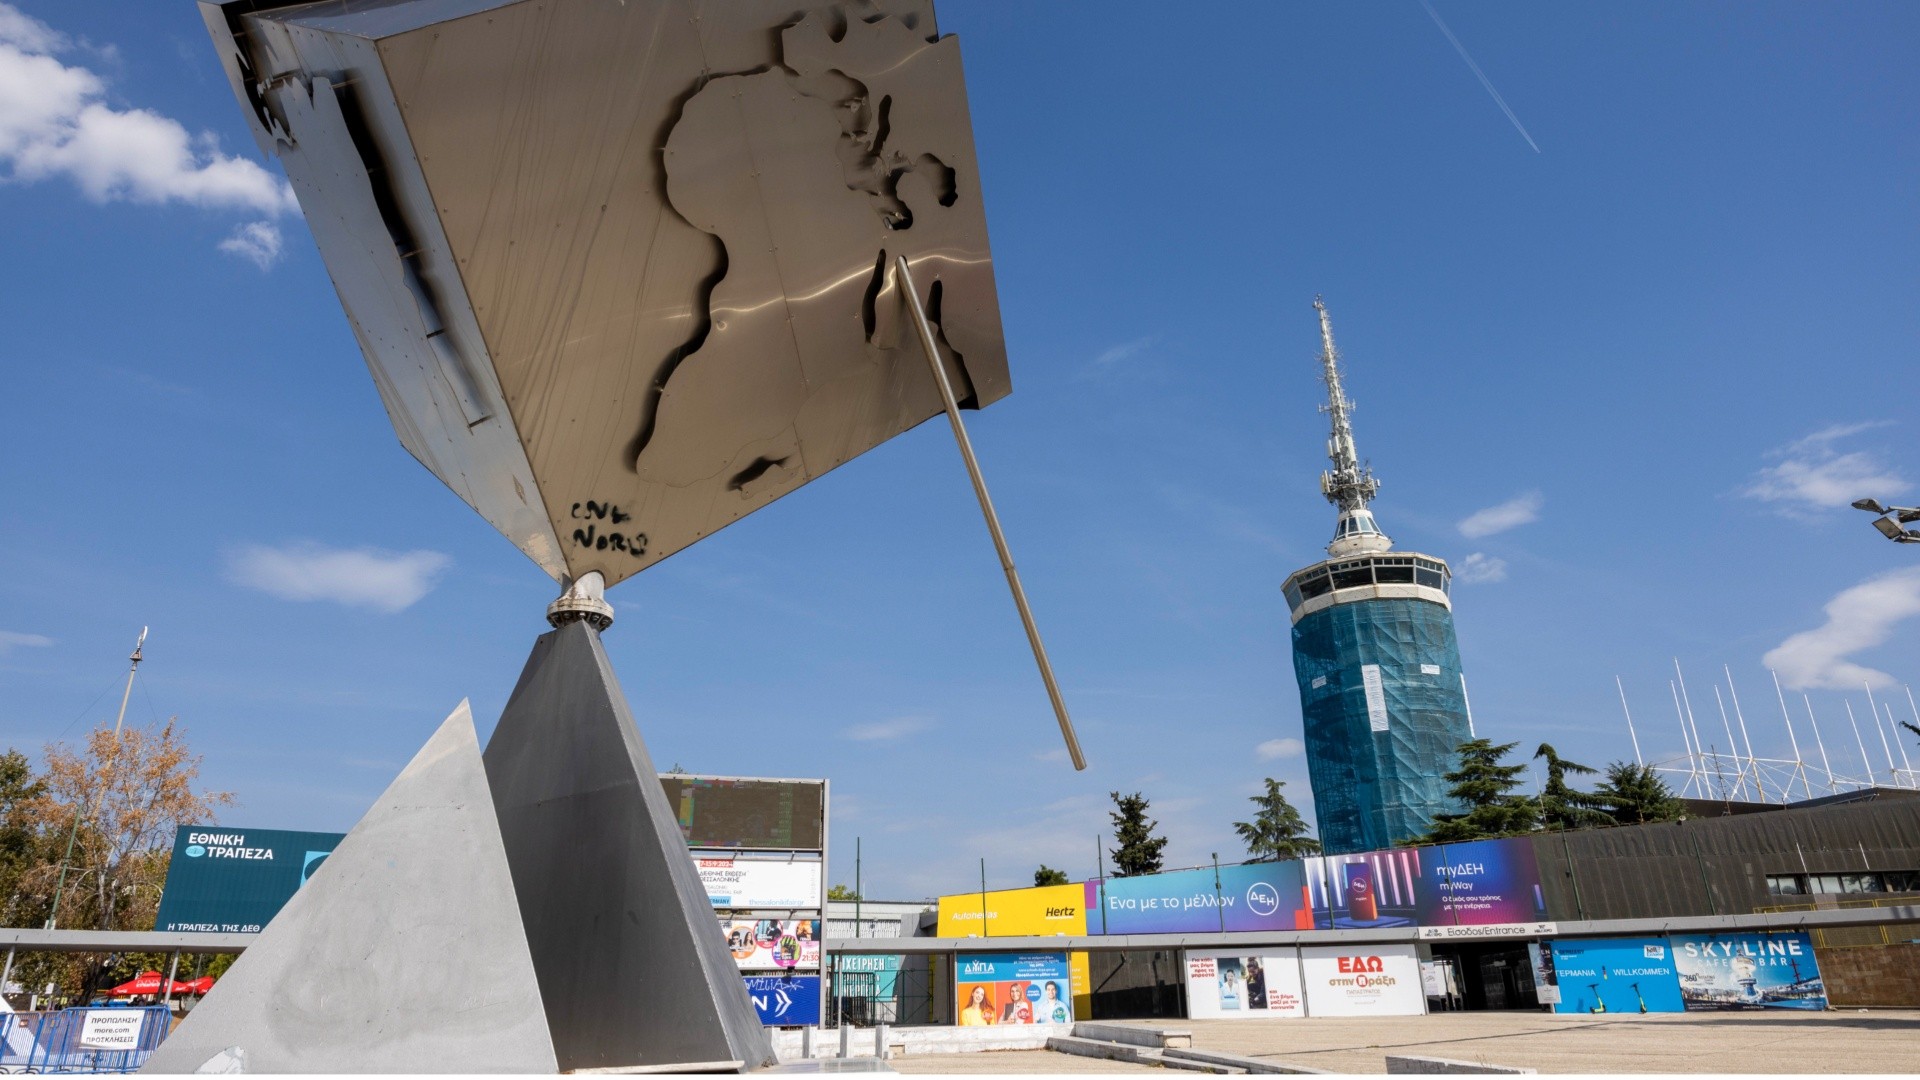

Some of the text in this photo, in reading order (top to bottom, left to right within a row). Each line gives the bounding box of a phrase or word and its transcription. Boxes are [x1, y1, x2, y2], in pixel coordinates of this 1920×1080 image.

[188, 832, 245, 846] ΕΘΝΙΚΗ
[207, 846, 274, 860] ΤΡΑΠΕΖΑ
[1440, 882, 1473, 891] myWay
[1108, 894, 1235, 912] Ένα με το μέλλον
[1250, 892, 1275, 906] ΔΕΗ
[952, 911, 998, 921] Autoheas
[1046, 907, 1075, 917] Hertz
[178, 924, 219, 932] ΤΡΑΠΕΖΑ
[1337, 956, 1383, 973] ΕΔΩ
[1697, 957, 1788, 967] CAFE BAR
[1613, 967, 1670, 977] WILLKOMMEN
[1329, 977, 1355, 987] στην
[86, 1036, 134, 1044] ΠΡΟΣΚΛΗΣΕΙΣ
